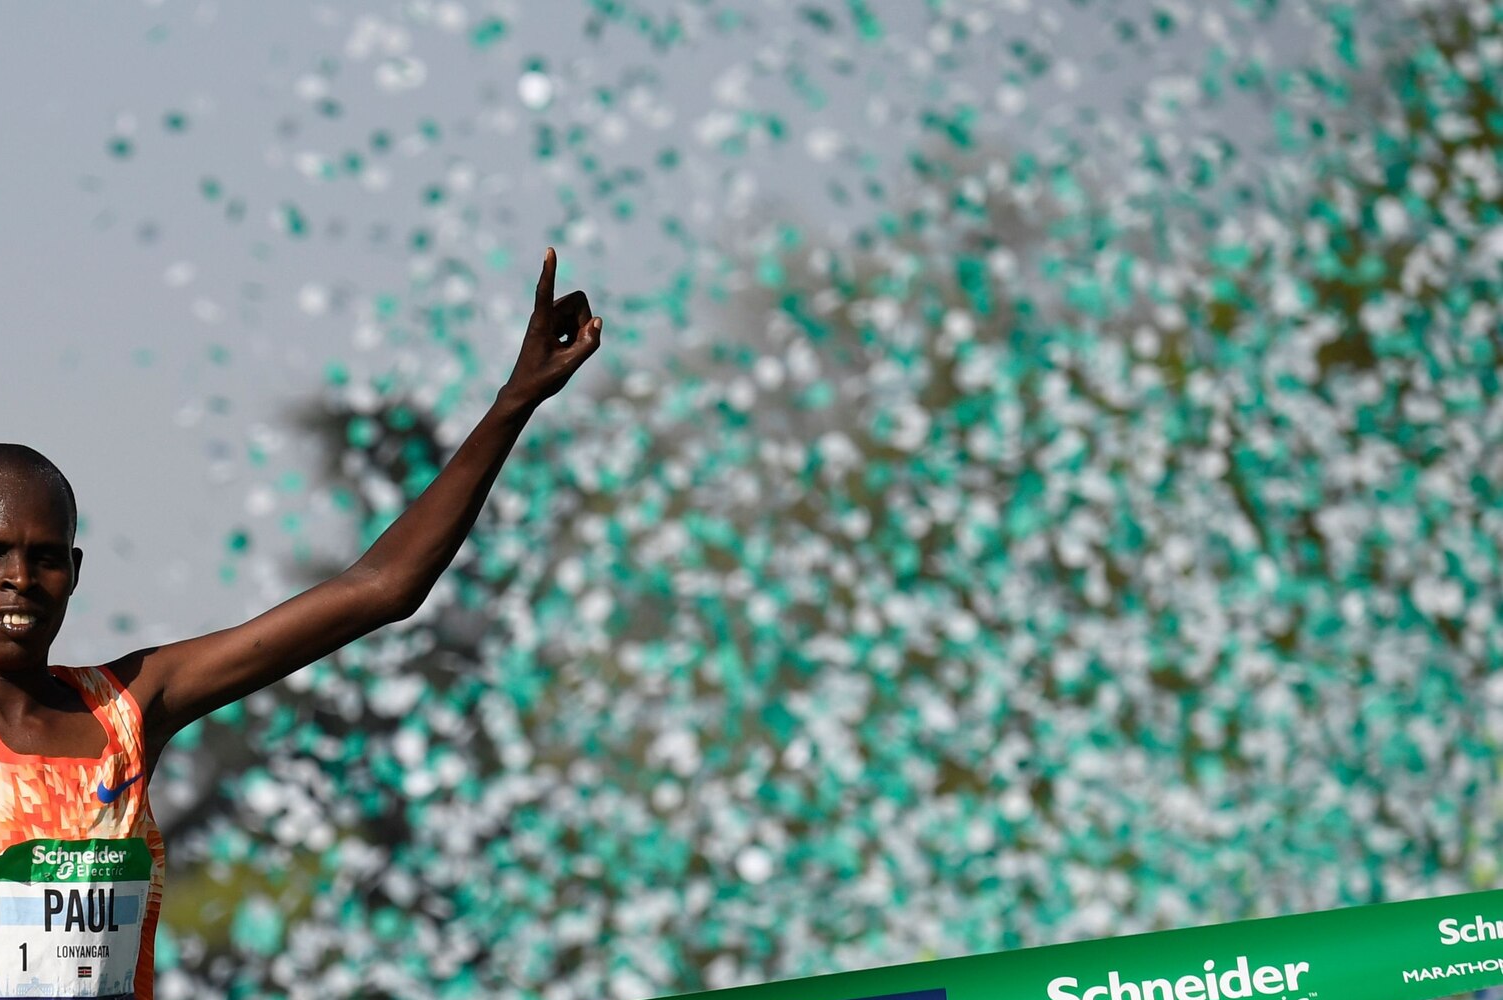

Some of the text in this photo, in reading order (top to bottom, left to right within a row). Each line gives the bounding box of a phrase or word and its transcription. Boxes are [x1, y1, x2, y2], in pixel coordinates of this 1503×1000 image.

[32, 846, 127, 866] Schneider
[76, 866, 124, 878] Electric
[43, 888, 119, 934] PAUL
[19, 942, 28, 972] 1
[56, 945, 110, 959] LONYANGATA
